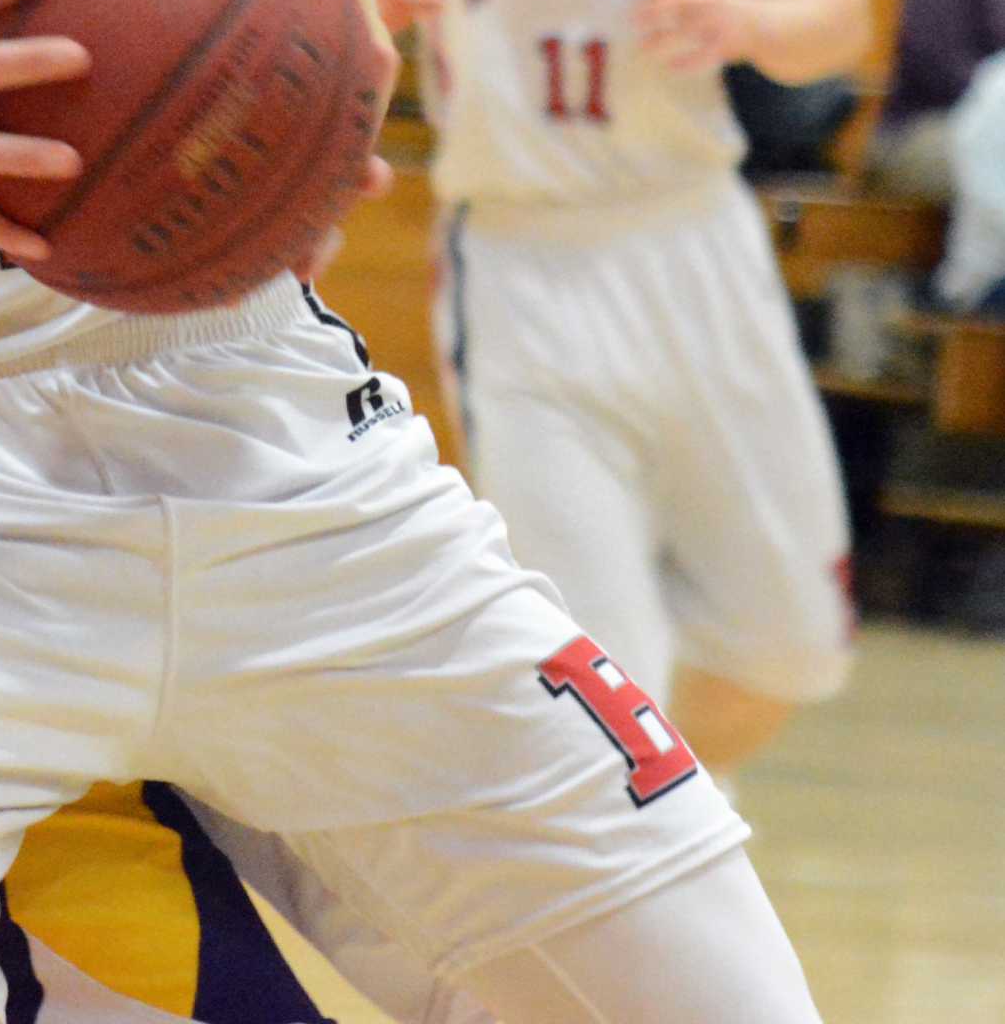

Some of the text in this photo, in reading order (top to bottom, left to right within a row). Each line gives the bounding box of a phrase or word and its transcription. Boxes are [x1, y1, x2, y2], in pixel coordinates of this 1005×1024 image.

[541, 36, 609, 124] 11
[346, 376, 384, 427] R
[347, 400, 406, 442] RUSSELL
[536, 634, 698, 808] B
